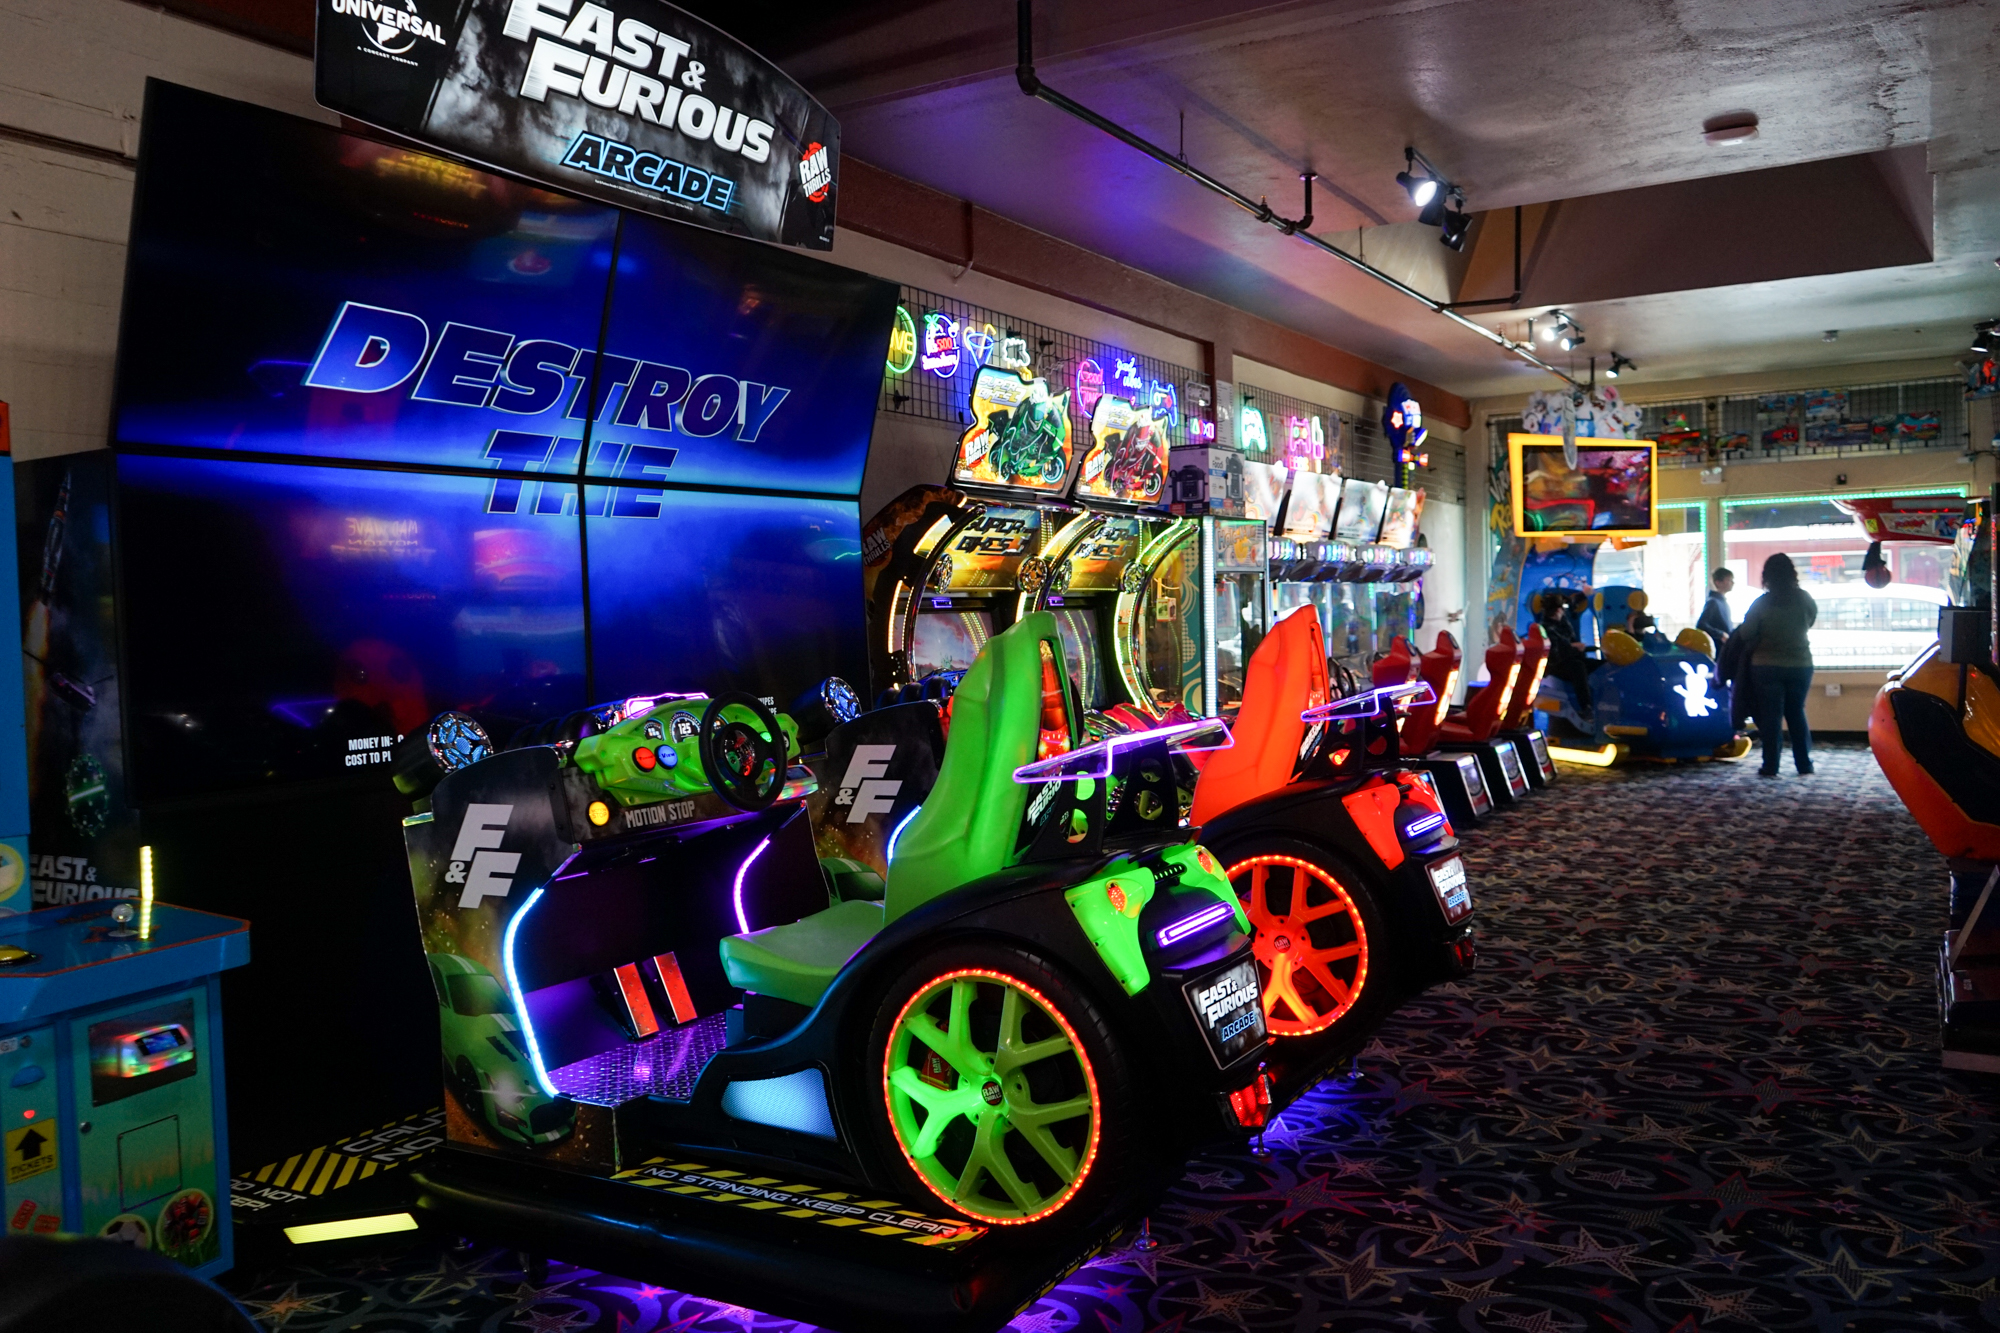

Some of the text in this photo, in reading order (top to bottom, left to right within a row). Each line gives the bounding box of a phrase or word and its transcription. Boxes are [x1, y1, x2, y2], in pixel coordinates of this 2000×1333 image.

[331, 0, 446, 45] UNIVERSAL
[502, 0, 706, 91] FAST &
[520, 36, 775, 164] FURIOUS
[559, 130, 734, 213] ARCADE
[799, 146, 828, 185] RAW
[803, 167, 832, 198] THRILLS
[302, 300, 791, 442] DESTROY
[978, 375, 1018, 392] SUPER
[965, 430, 989, 458] RAW
[1086, 450, 1105, 474] RAW
[482, 429, 679, 520] THE
[348, 737, 379, 750] MONEY
[381, 735, 393, 747] IN:
[677, 722, 692, 735] 125
[345, 753, 367, 766] COST
[368, 752, 380, 764] TO
[840, 744, 897, 789] F
[624, 800, 696, 828] MOTION STOP
[834, 780, 903, 824] & F
[1031, 780, 1062, 826] FURIO
[450, 803, 514, 862] F
[85, 866, 97, 882] &
[445, 851, 522, 909] & F
[1199, 977, 1238, 1014] FAST &
[1206, 981, 1258, 1029] FURIOUS
[1221, 1010, 1256, 1043] ARCADE
[982, 1084, 1001, 1098] RAW
[11, 1154, 53, 1174] TICKETS
[253, 1187, 308, 1204] NOT
[643, 1166, 957, 1237] NO STANDING KEEP CLEAR
